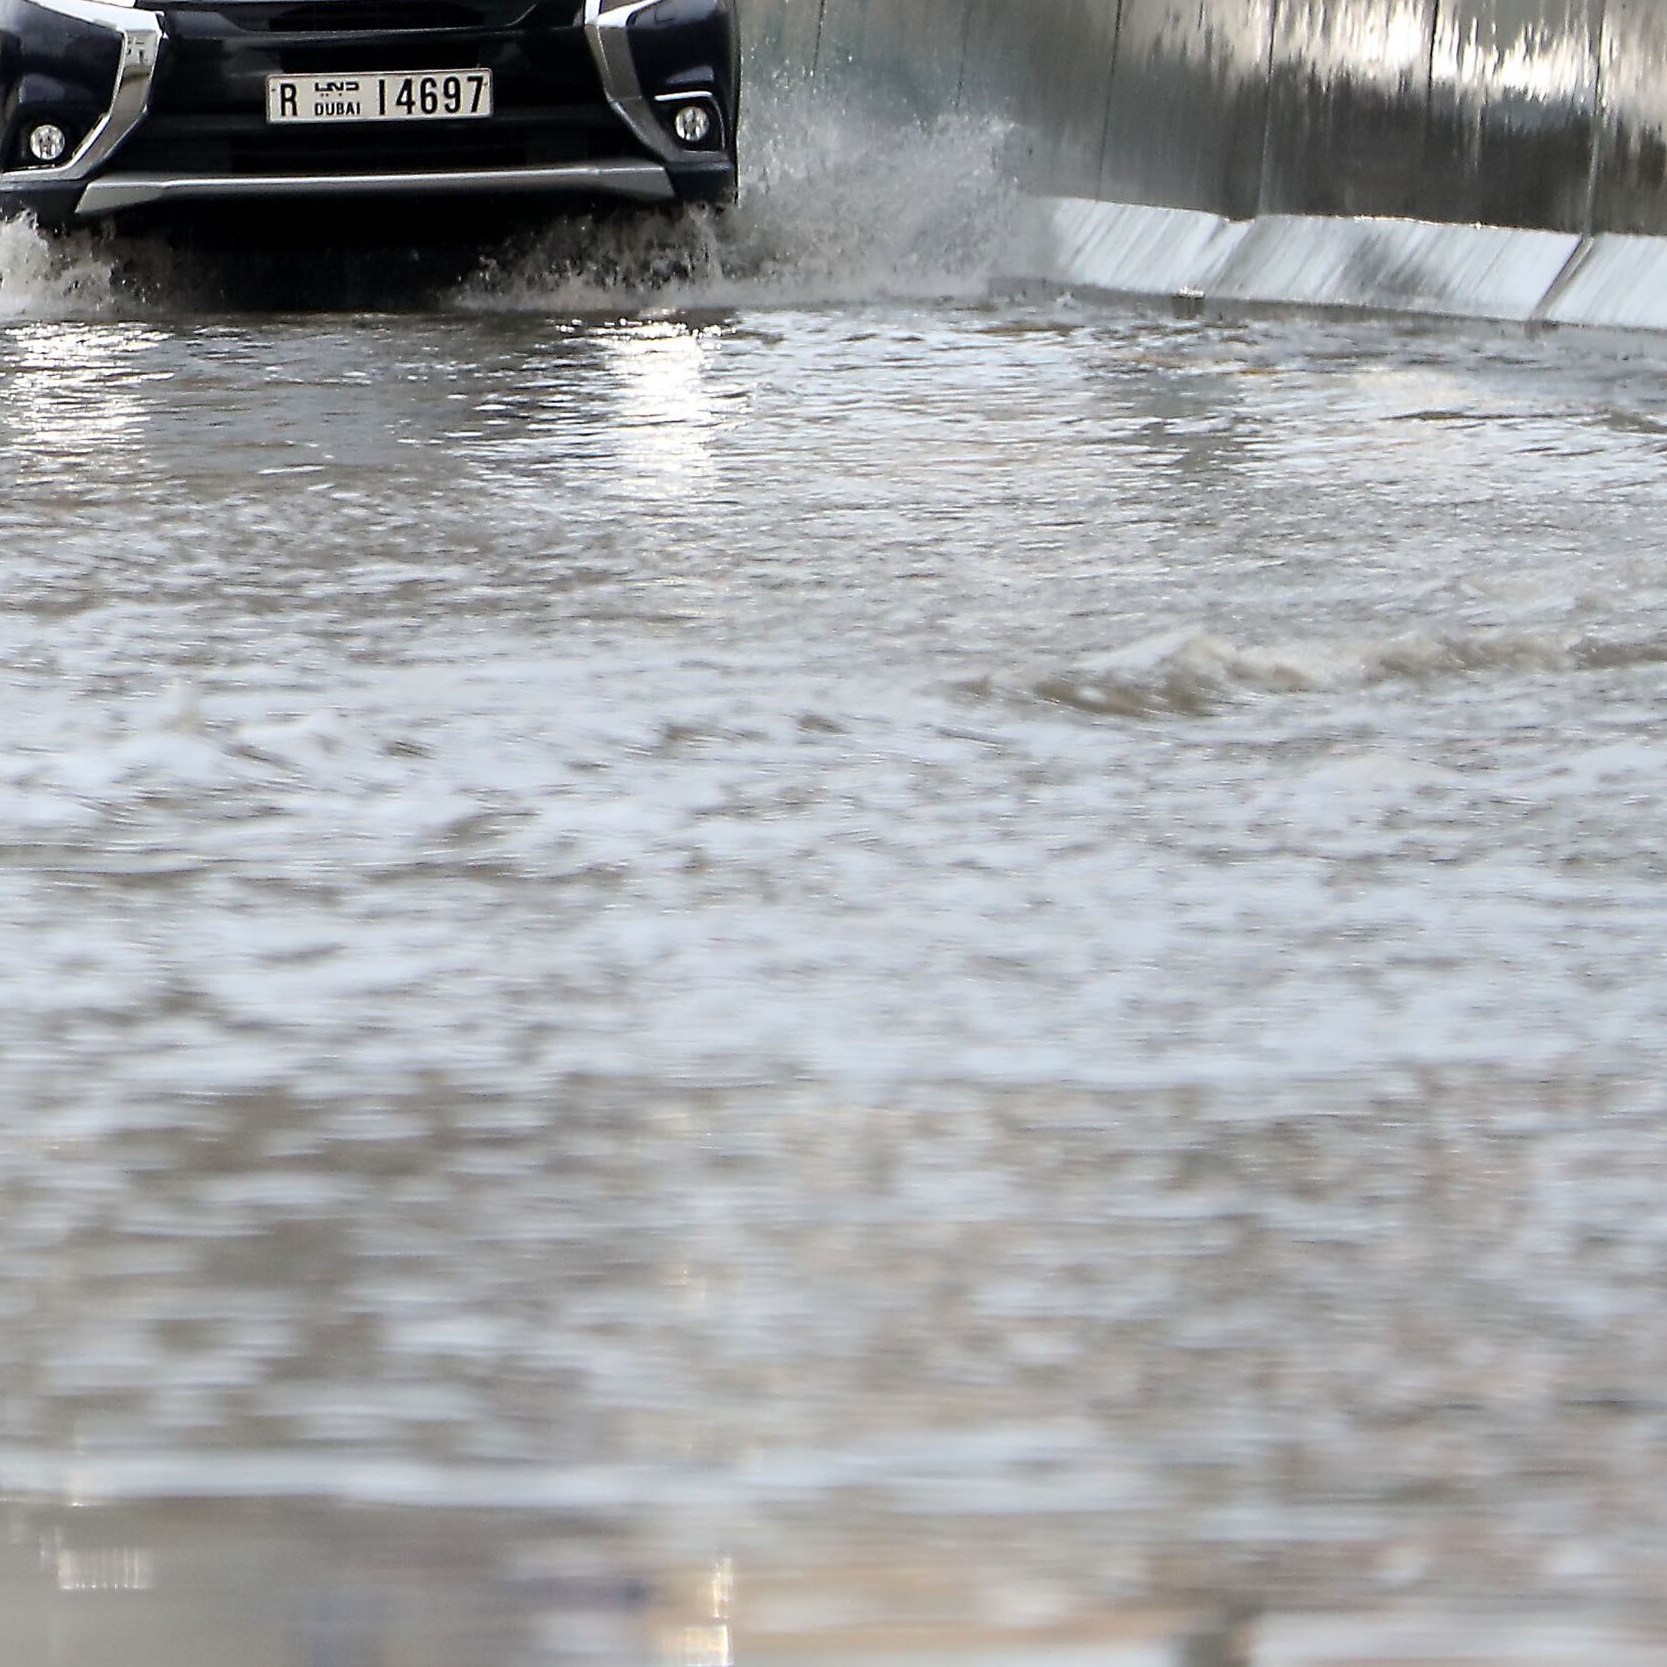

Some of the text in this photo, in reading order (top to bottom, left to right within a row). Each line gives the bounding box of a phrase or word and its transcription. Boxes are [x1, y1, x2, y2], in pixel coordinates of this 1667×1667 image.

[280, 76, 484, 117] R 14697
[315, 102, 361, 116] DUBAI
